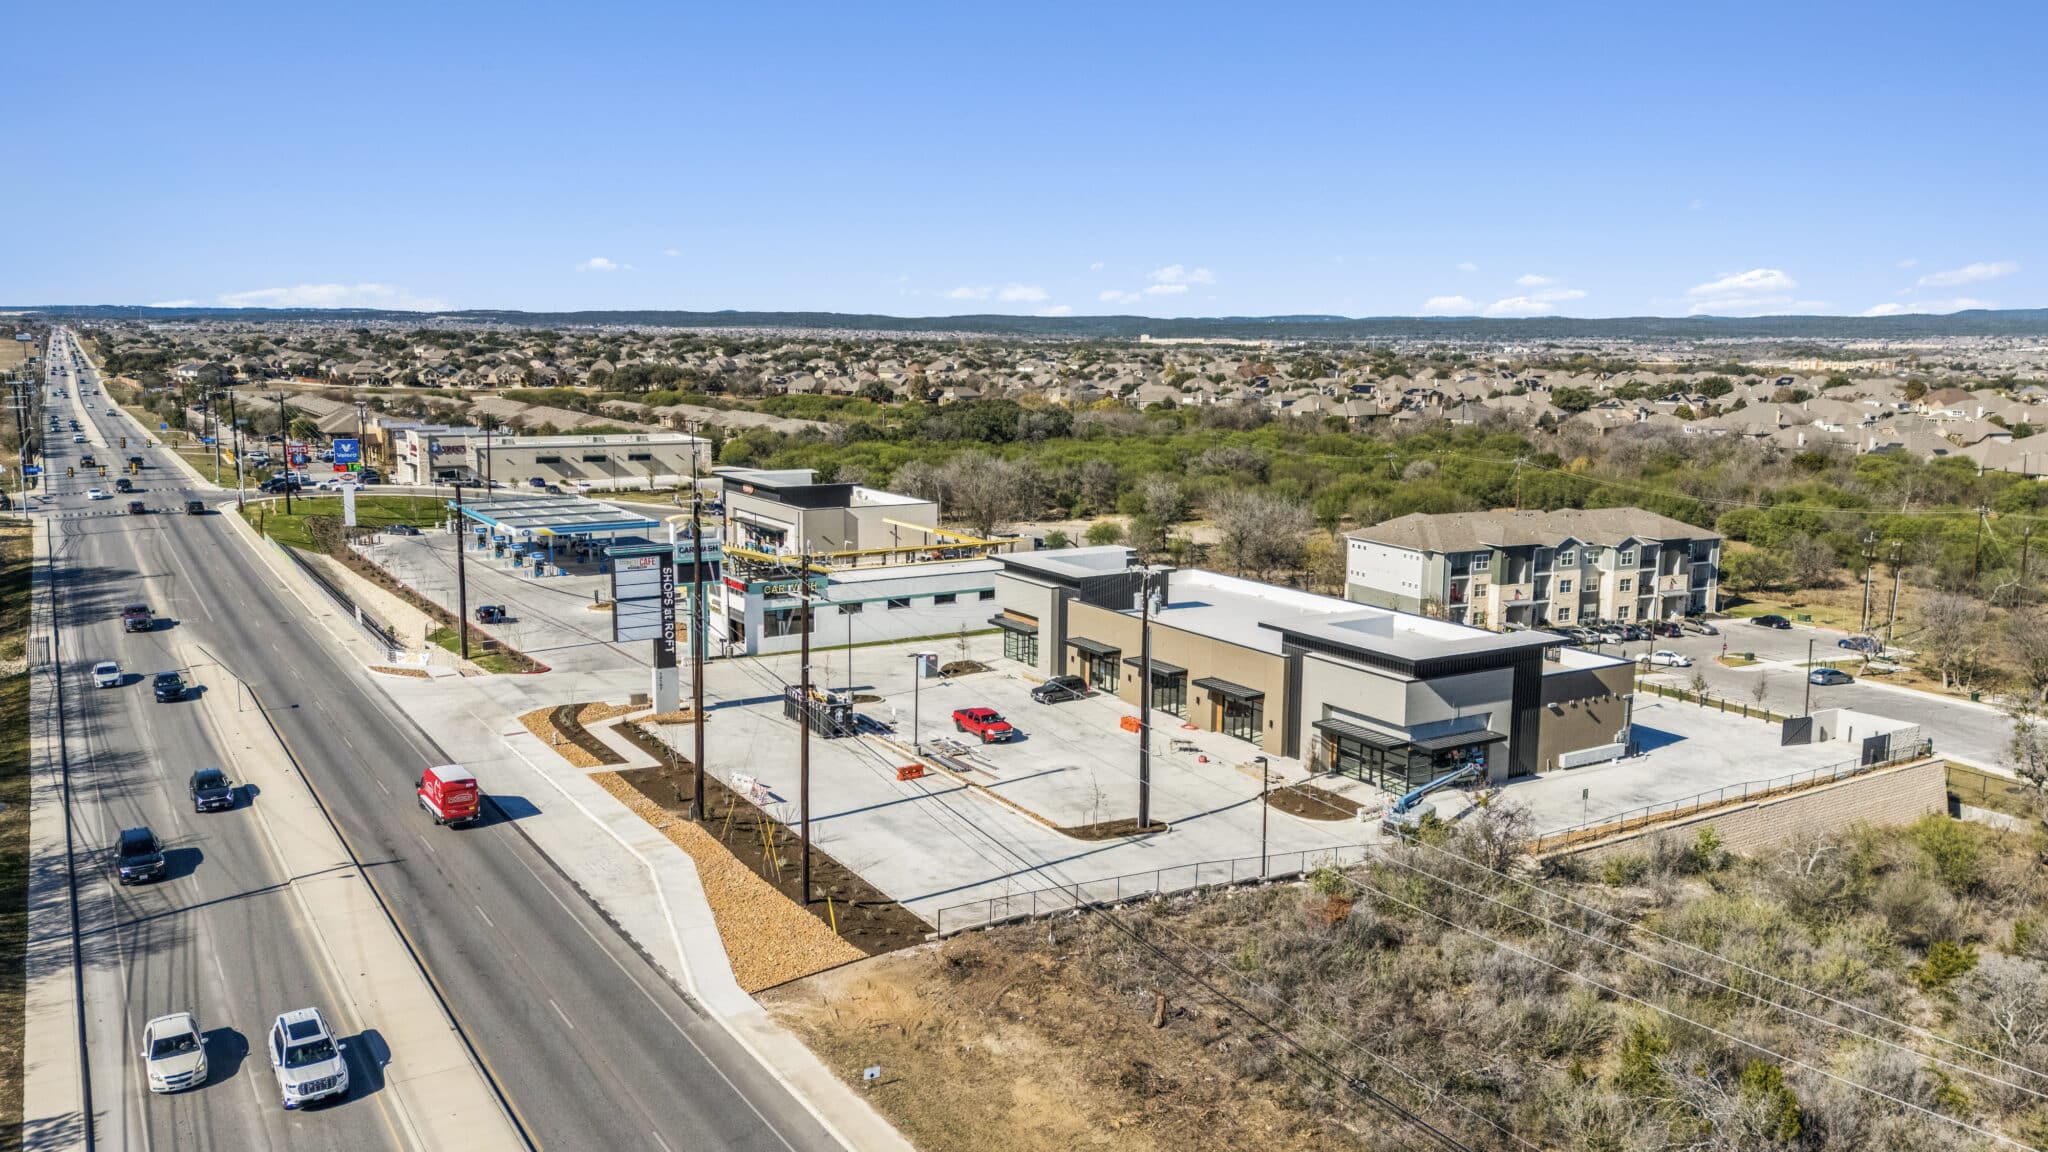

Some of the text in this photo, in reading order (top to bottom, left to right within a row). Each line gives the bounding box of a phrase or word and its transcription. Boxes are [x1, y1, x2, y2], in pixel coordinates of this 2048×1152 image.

[678, 546, 694, 554] CAR
[640, 557, 657, 567] CAFE
[763, 584, 785, 595] CAR
[663, 567, 675, 654] SHOPS at ROFT
